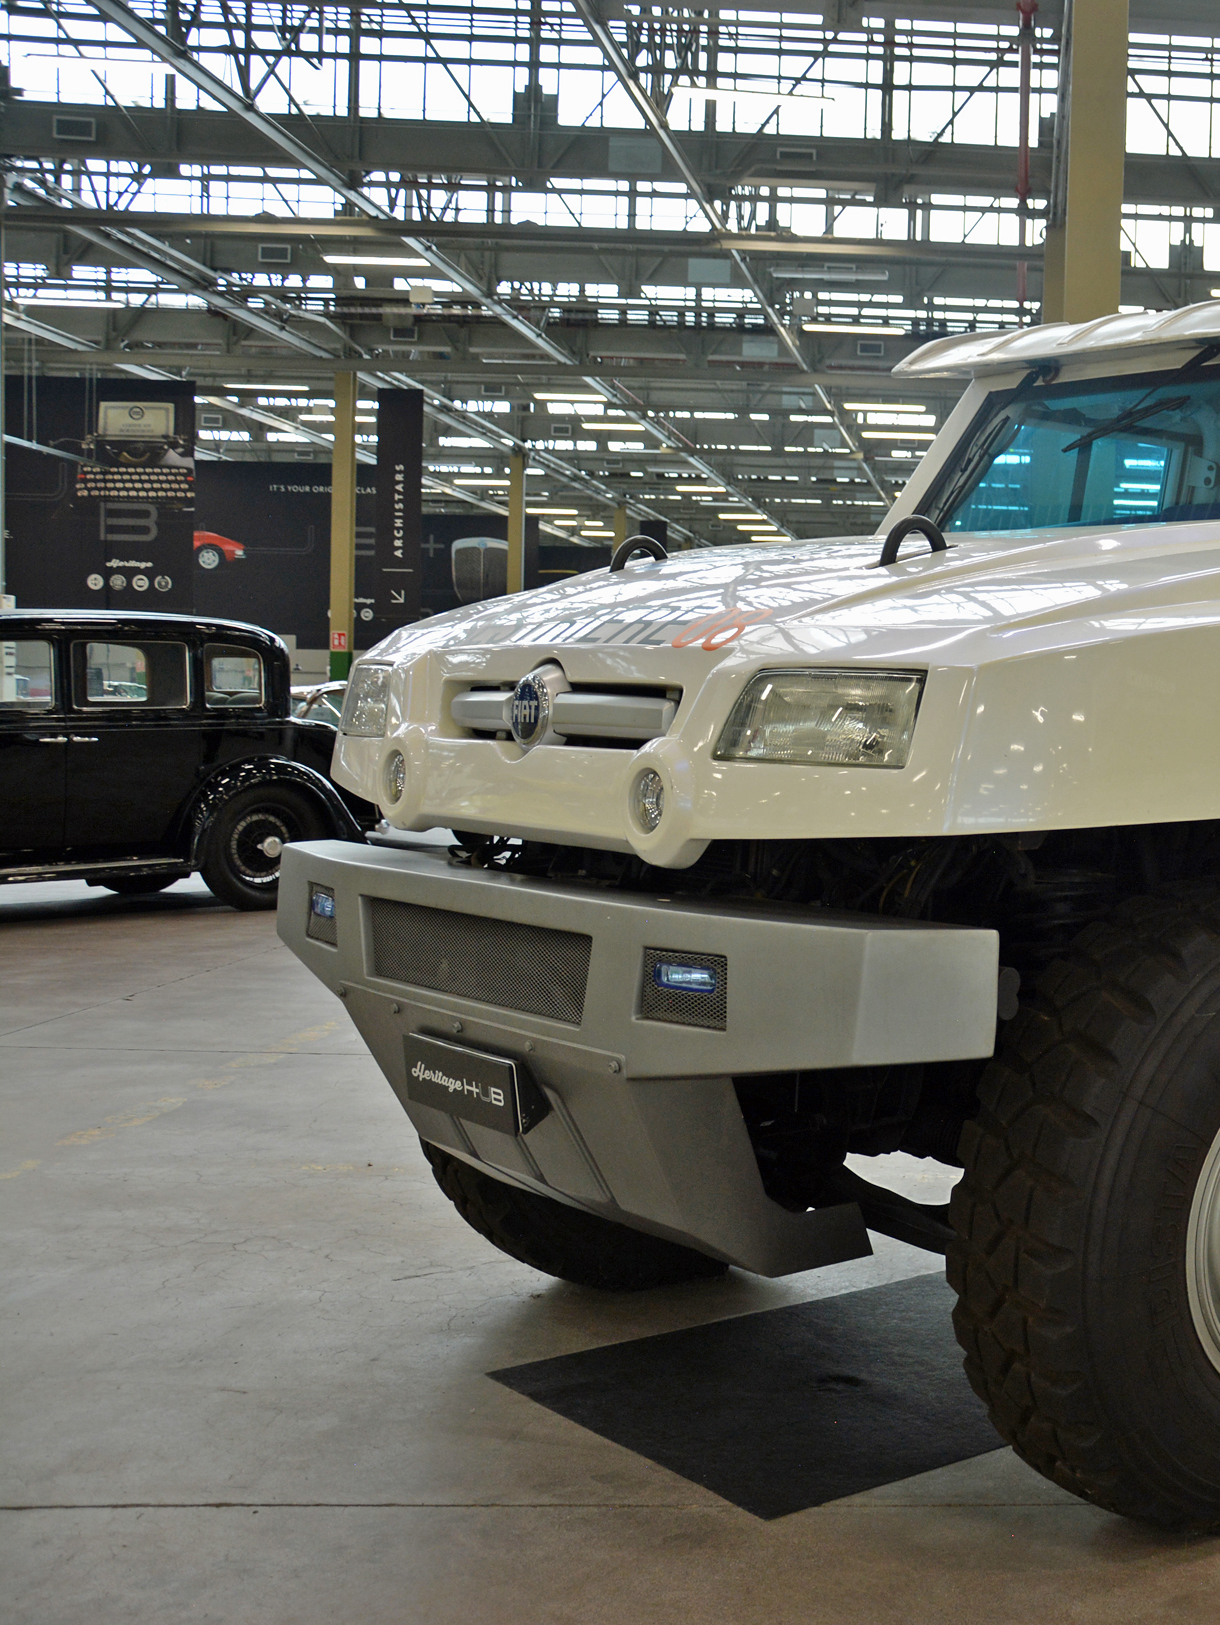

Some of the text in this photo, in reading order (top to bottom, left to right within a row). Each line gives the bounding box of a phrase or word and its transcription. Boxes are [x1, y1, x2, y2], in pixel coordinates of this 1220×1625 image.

[393, 464, 405, 558] ARCHISTARS
[105, 558, 154, 569] Heritage
[671, 607, 774, 651] 08
[513, 700, 538, 723] FIAT
[411, 1061, 505, 1107] Heritage HUB
